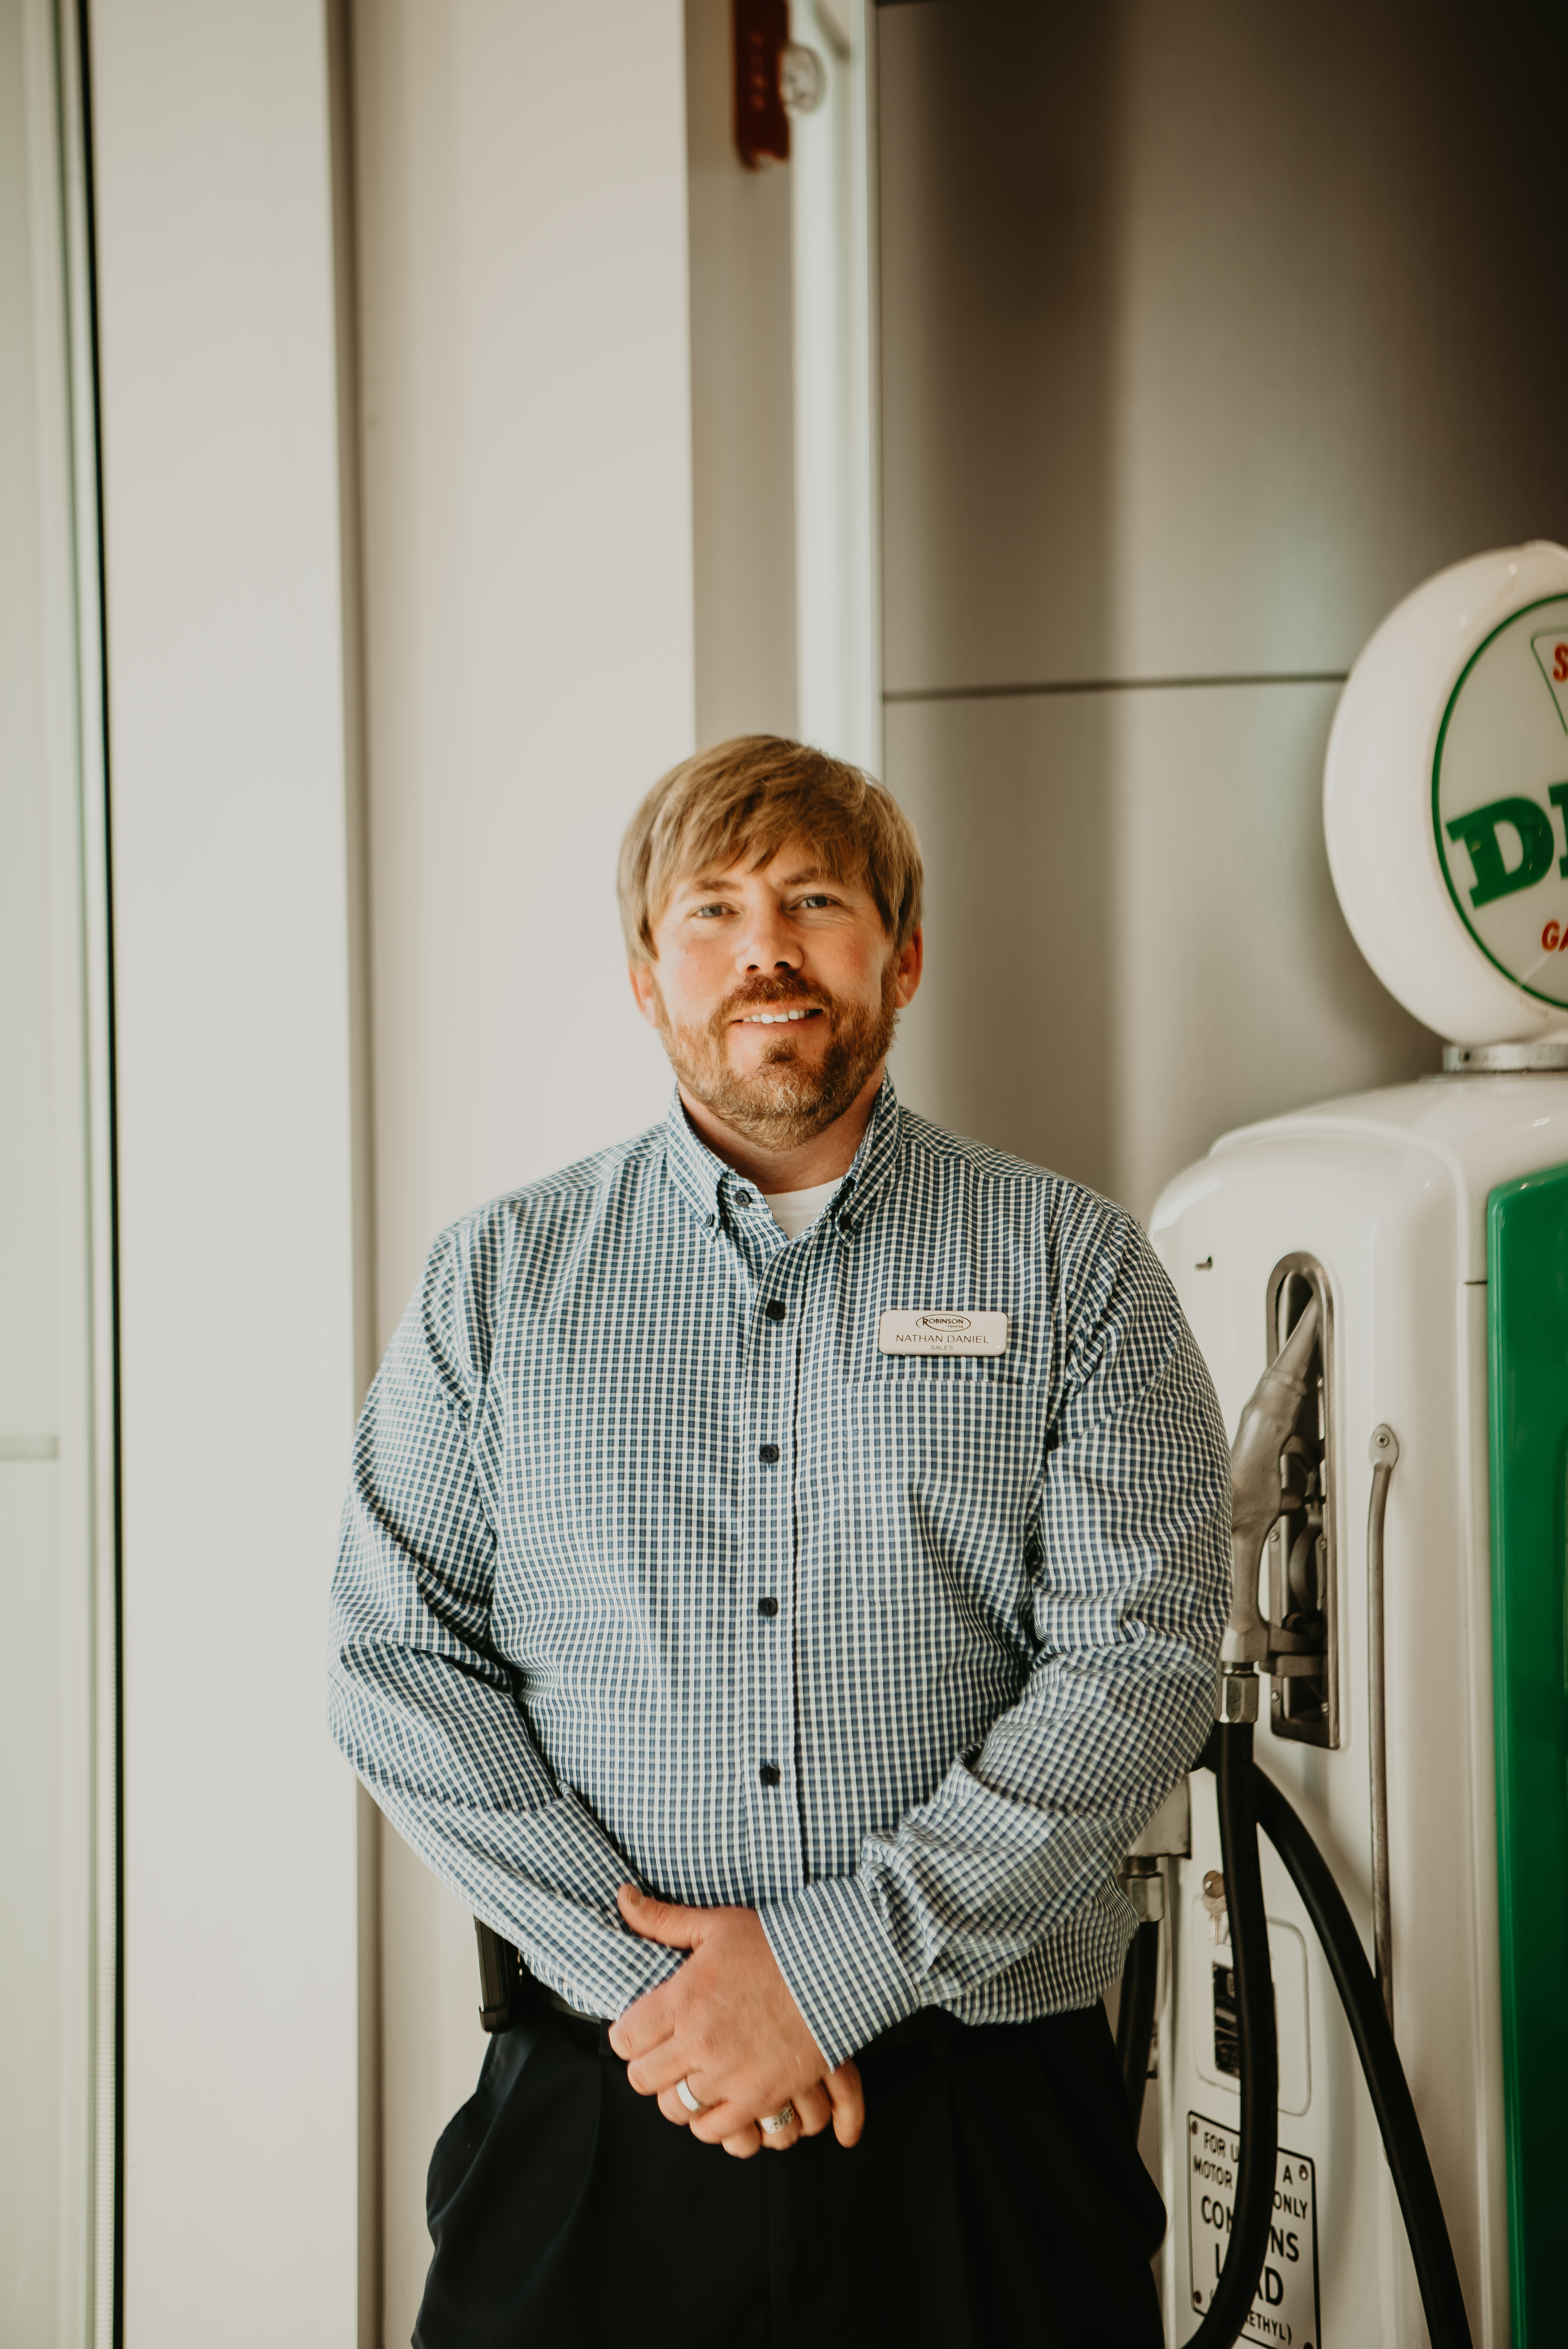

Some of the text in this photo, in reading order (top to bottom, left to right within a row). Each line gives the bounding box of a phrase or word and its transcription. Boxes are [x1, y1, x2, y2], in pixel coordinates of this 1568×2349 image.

[922, 1318, 964, 1326] ROBINSON
[896, 1334, 989, 1344] NATHAN DANIEL
[1204, 2131, 1227, 2158] FOR
[1282, 2164, 1293, 2185] A
[1193, 2154, 1308, 2220] MOTOR ONLY
